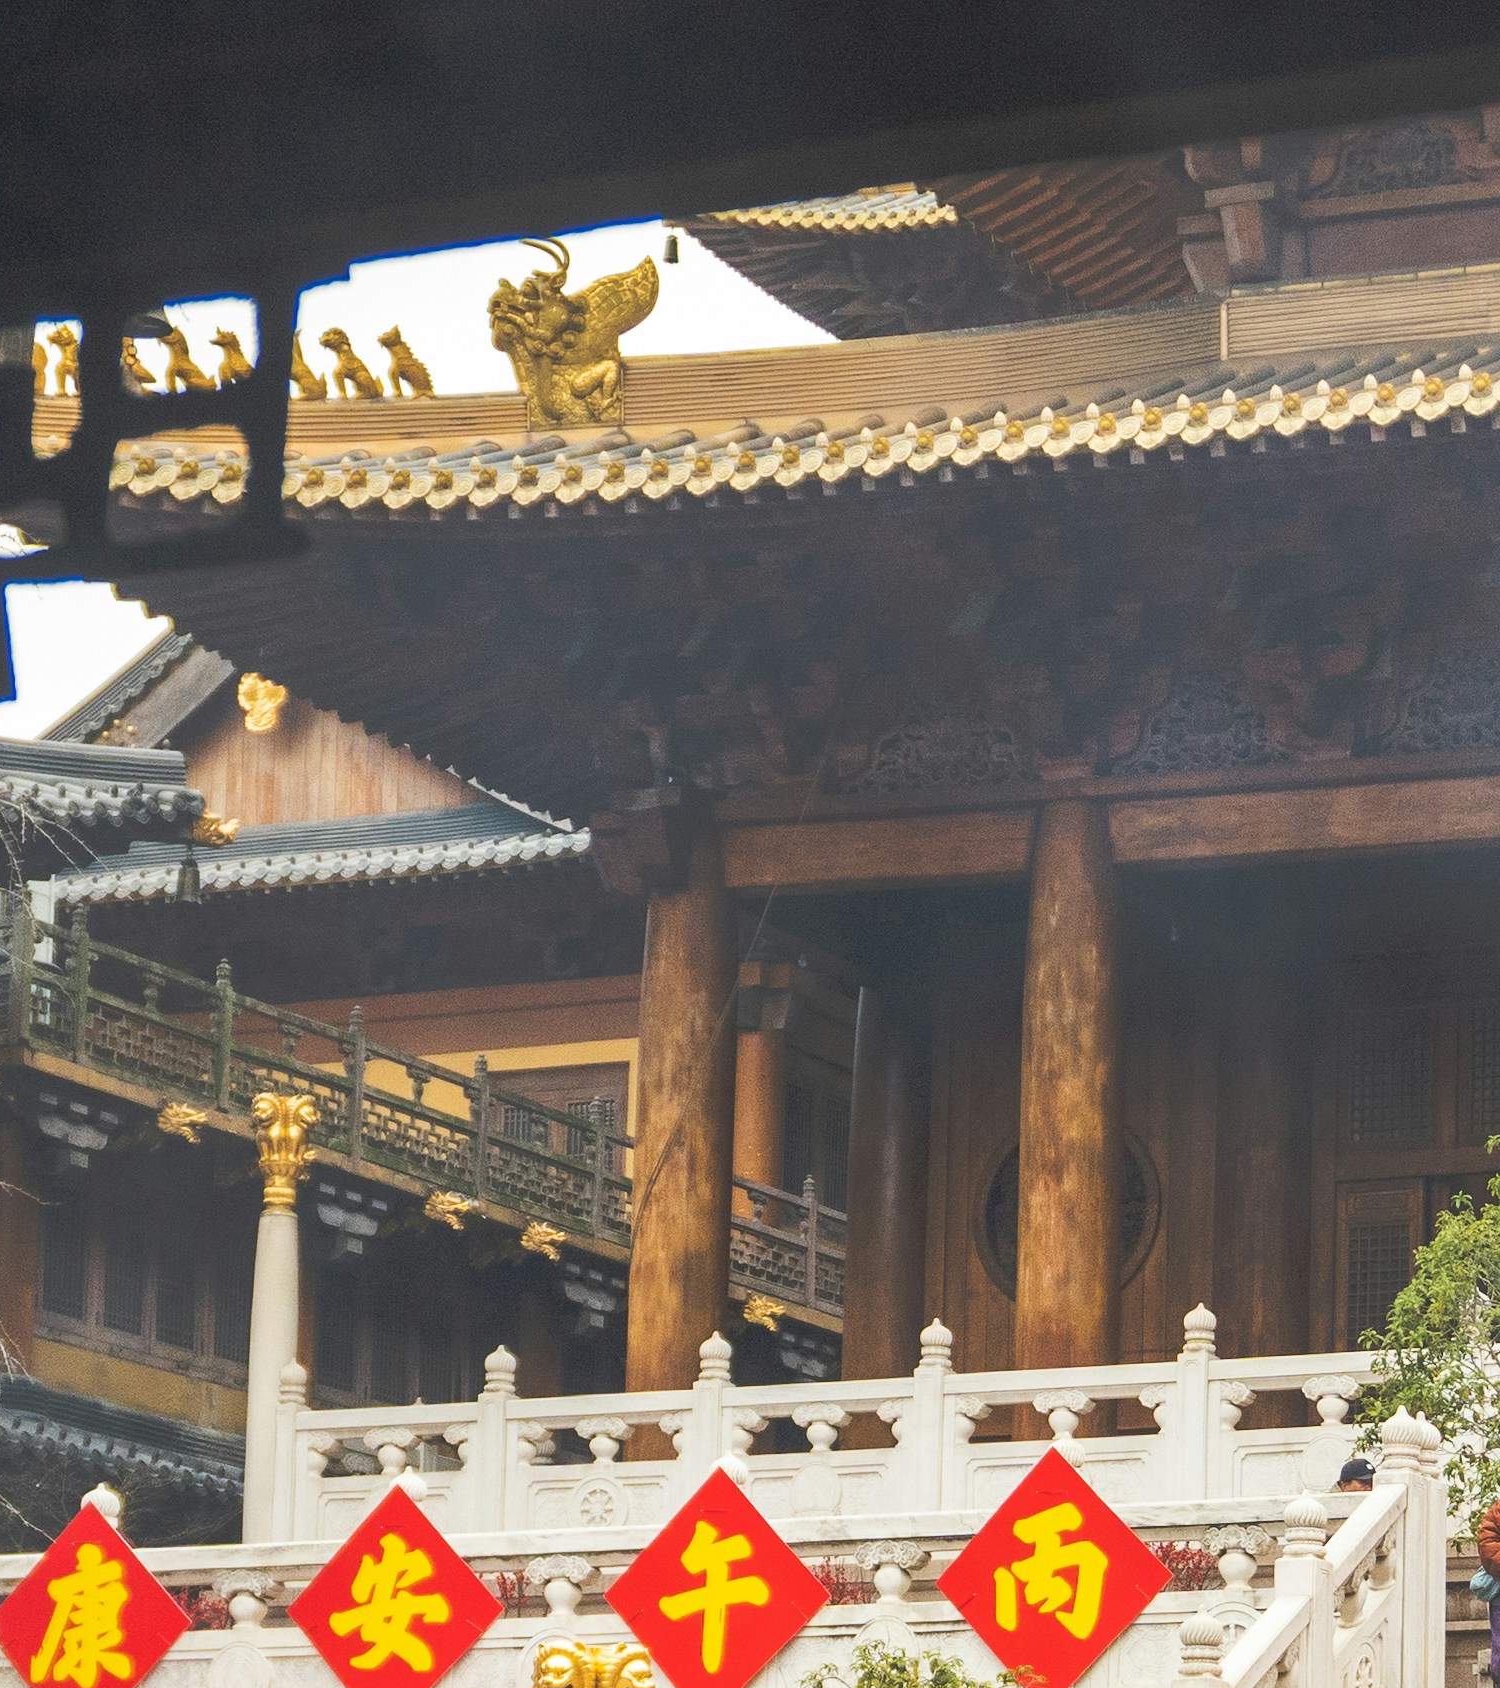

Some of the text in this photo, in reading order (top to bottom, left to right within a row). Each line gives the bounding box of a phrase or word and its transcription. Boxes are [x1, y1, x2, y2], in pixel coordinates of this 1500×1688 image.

[30, 1543, 132, 1688] 康
[329, 1533, 450, 1672] 安
[659, 1520, 770, 1674] 午
[994, 1502, 1108, 1640] 丙
